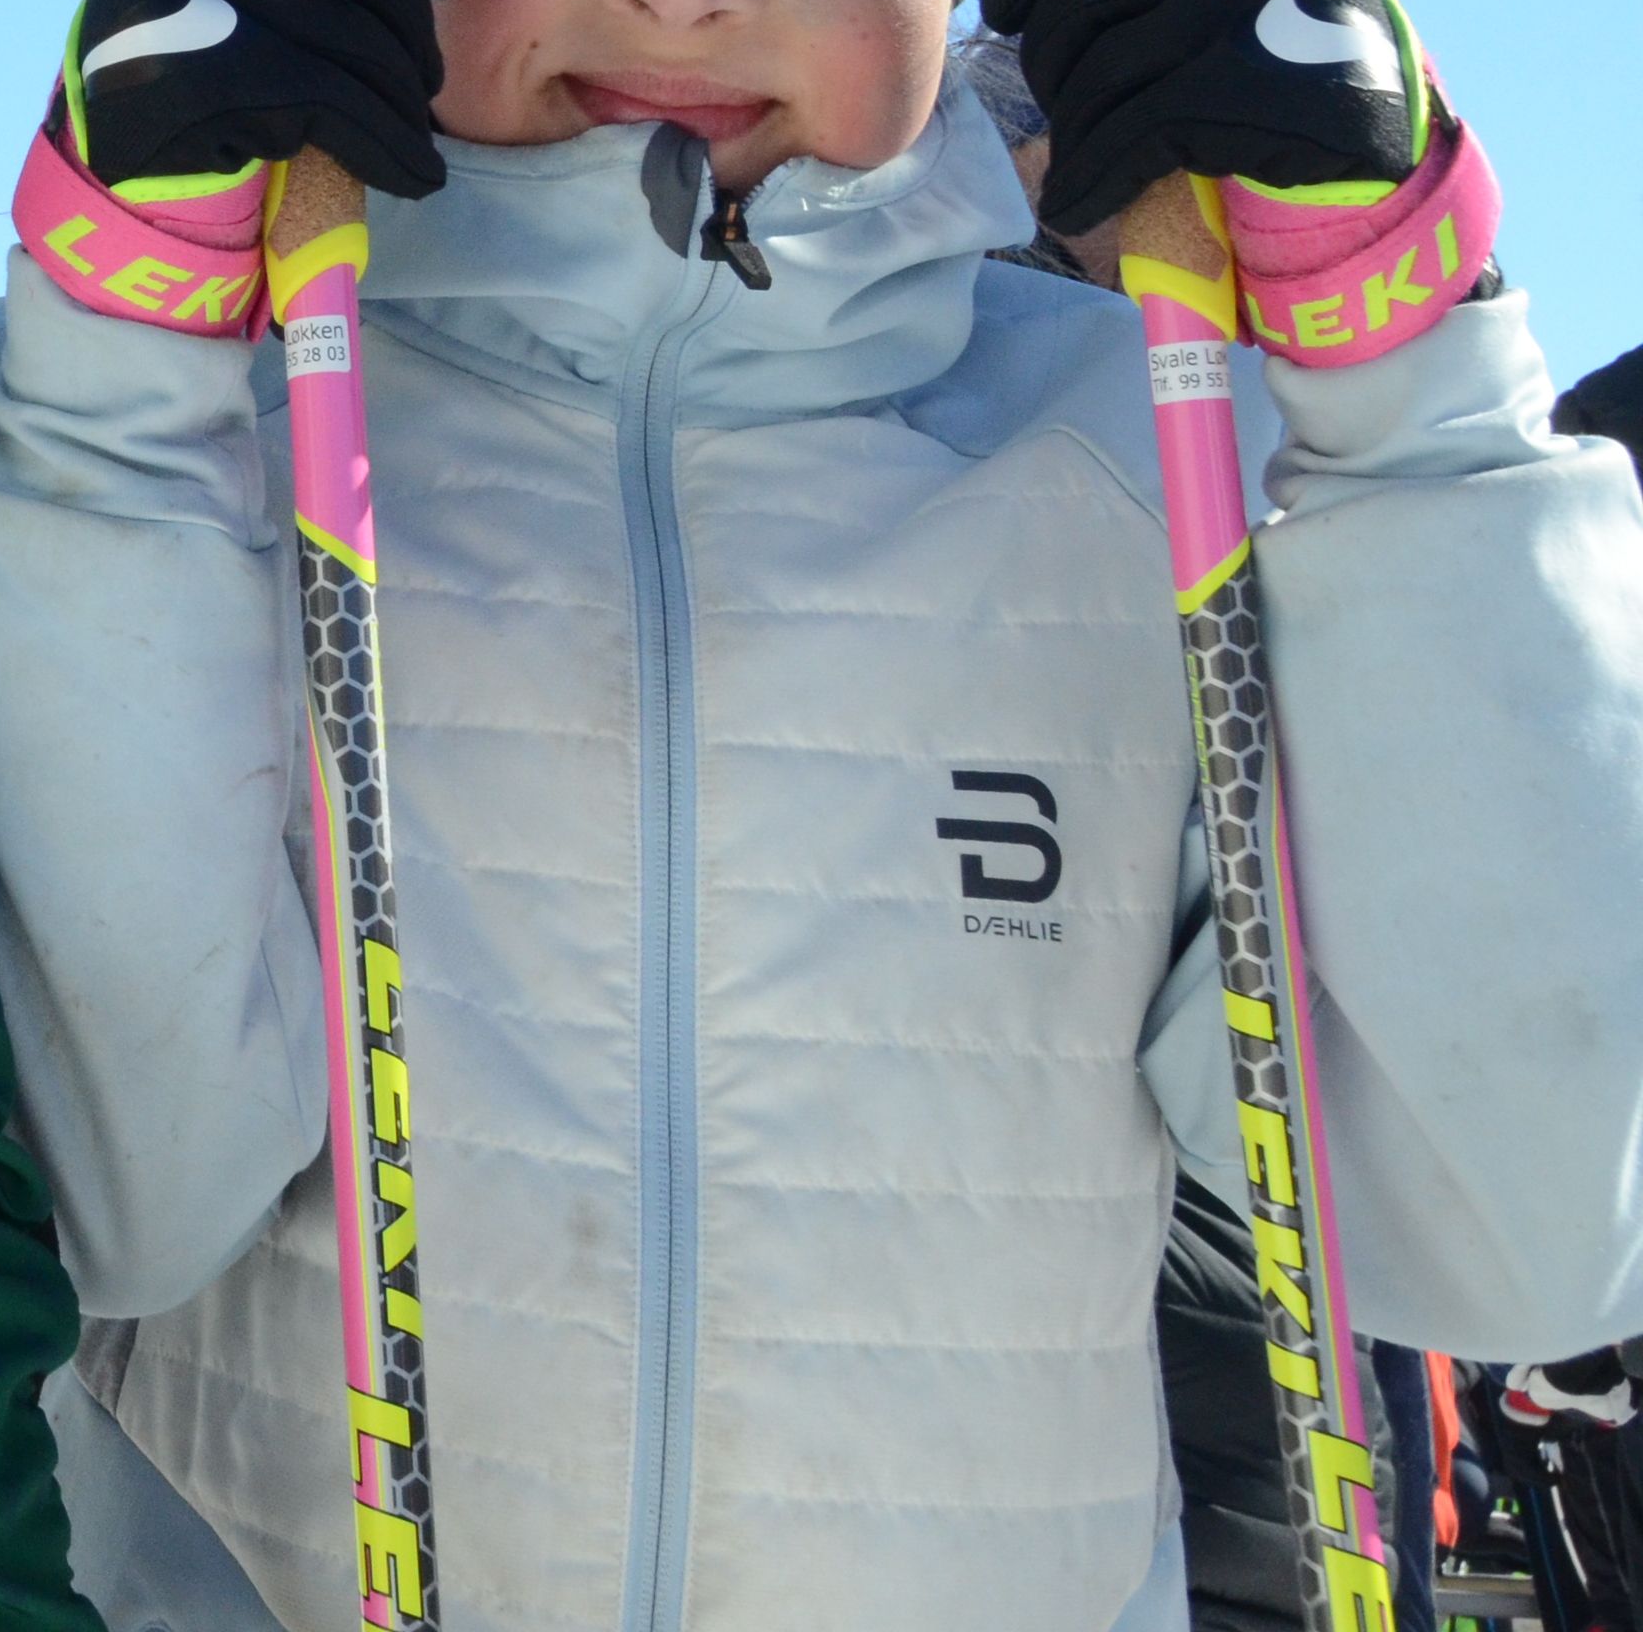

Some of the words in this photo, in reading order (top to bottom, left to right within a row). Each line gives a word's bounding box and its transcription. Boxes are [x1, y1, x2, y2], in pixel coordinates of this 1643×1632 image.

[43, 214, 261, 325] LEKI
[1246, 212, 1461, 350] LEKI
[302, 346, 322, 364] 28
[326, 345, 347, 361] 03
[1150, 348, 1199, 372] Svale
[1178, 372, 1201, 390] 99
[1206, 371, 1224, 388] 55
[964, 914, 1063, 943] DÆHLIE
